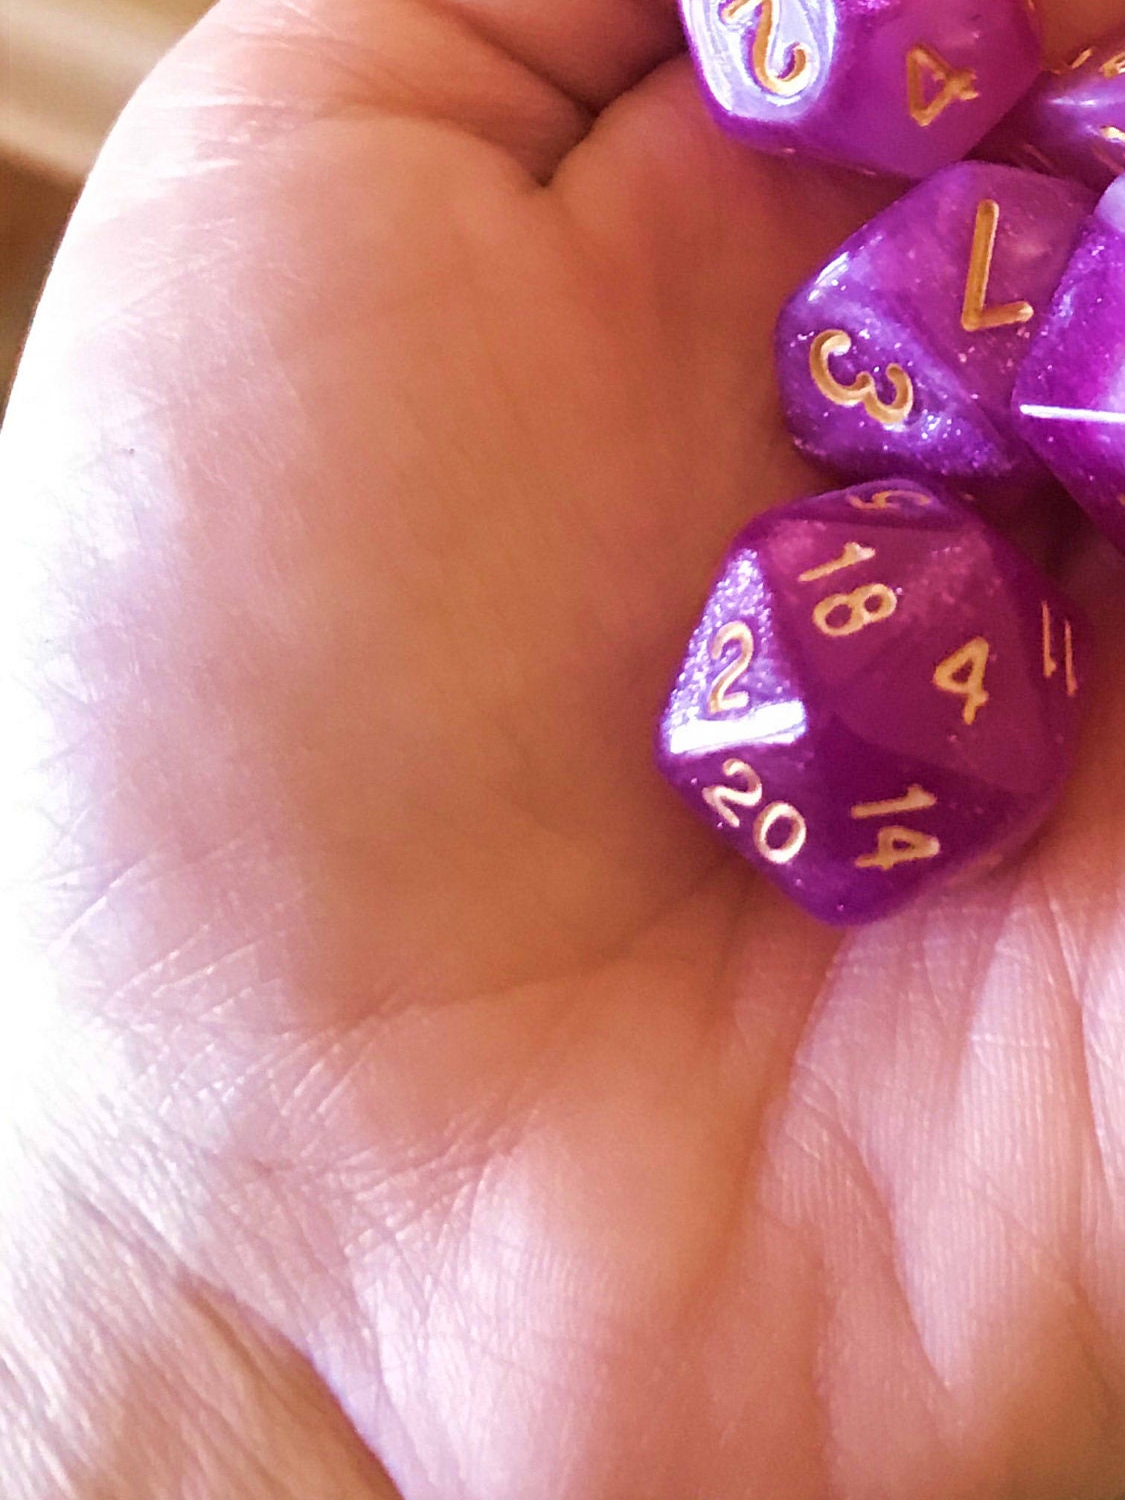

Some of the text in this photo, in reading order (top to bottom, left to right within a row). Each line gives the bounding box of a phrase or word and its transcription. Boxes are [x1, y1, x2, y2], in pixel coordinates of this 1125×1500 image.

[906, 44, 980, 127] 4
[961, 199, 1034, 332] 7
[809, 329, 914, 431] 3
[798, 541, 899, 638] 18
[708, 619, 754, 714] 2
[932, 636, 990, 726] 4
[702, 758, 808, 865] 20
[850, 783, 941, 870] 14
